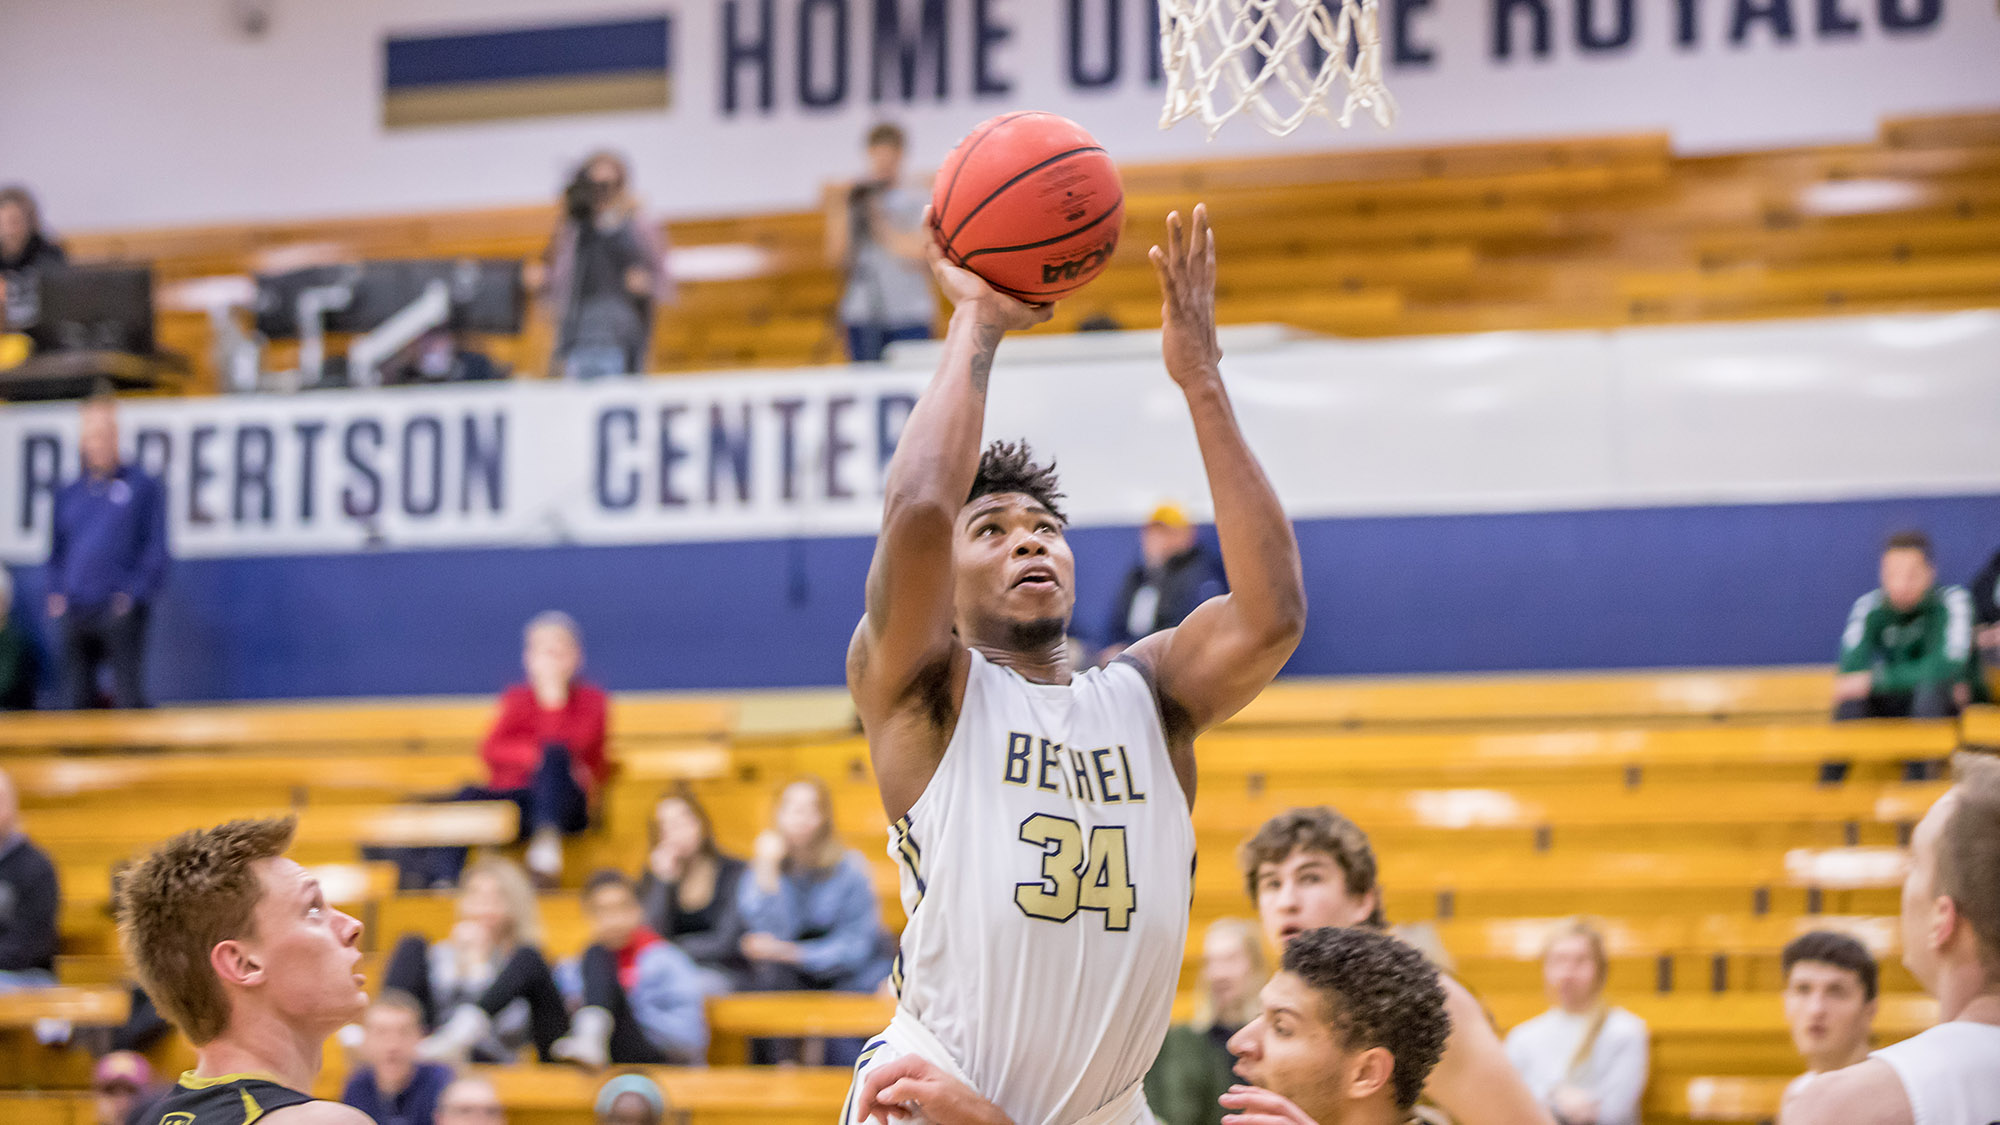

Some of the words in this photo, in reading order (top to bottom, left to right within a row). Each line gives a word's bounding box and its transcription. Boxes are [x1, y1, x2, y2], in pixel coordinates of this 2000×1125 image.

[720, 0, 1012, 116] HOME
[1003, 731, 1146, 804] BEHEL
[1014, 812, 1136, 931] 34
